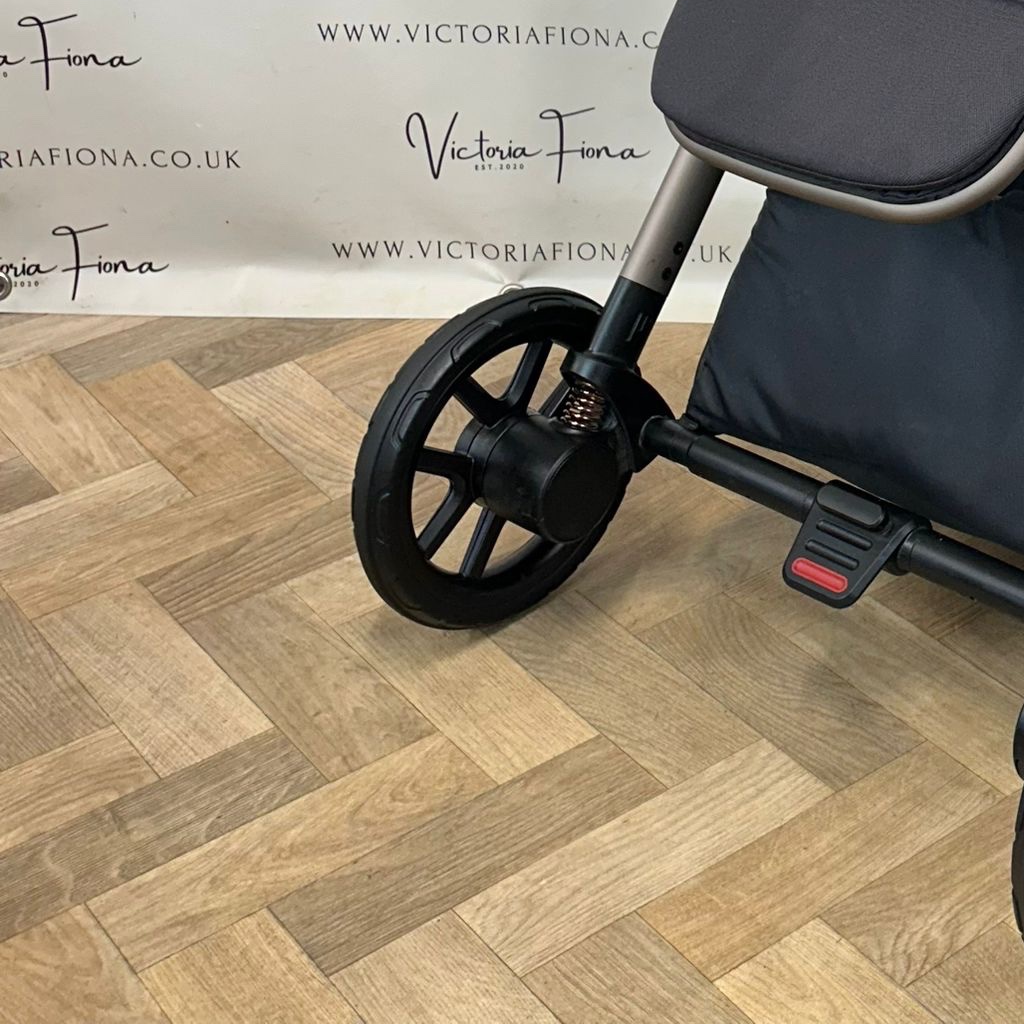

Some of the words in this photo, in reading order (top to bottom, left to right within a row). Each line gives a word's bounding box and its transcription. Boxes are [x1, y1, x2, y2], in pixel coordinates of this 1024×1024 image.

[17, 14, 142, 91] Fiona
[317, 23, 658, 49] WWW.VICTORIAFIONA.C
[405, 111, 542, 180] Victoria
[539, 107, 651, 184] Fiona
[475, 163, 524, 171] EST.2020
[52, 223, 169, 301] Fiona
